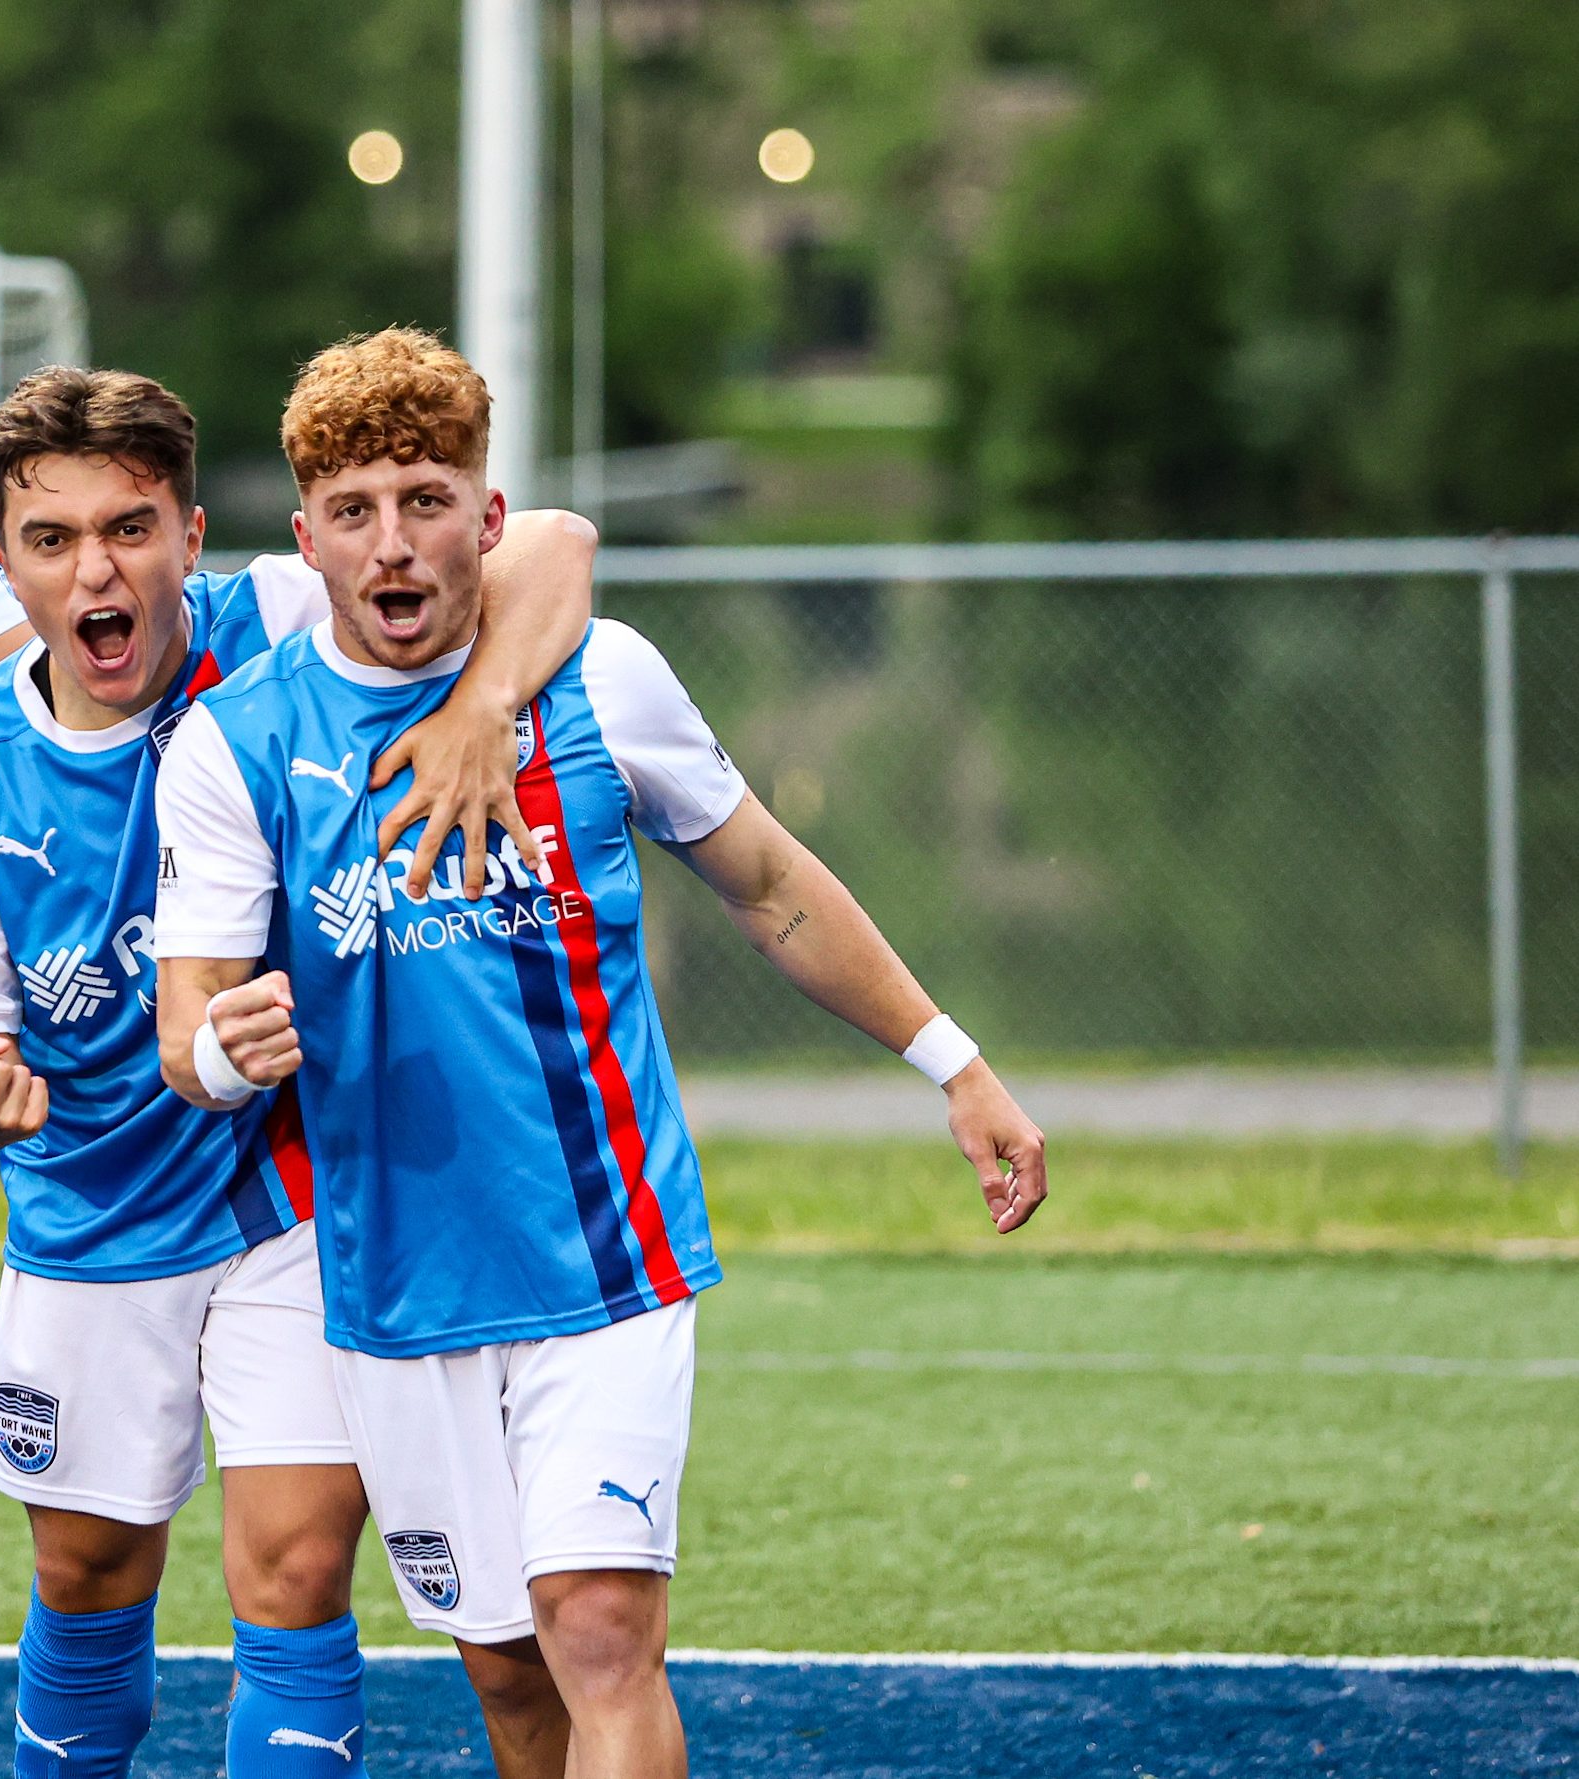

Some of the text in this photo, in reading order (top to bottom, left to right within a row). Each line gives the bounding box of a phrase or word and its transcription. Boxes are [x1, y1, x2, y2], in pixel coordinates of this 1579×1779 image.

[385, 891, 583, 957] MORTGAGE
[777, 910, 808, 944] OHANA
[20, 1422, 53, 1441] WAYNE
[400, 1562, 453, 1576] FORT WAYNE
